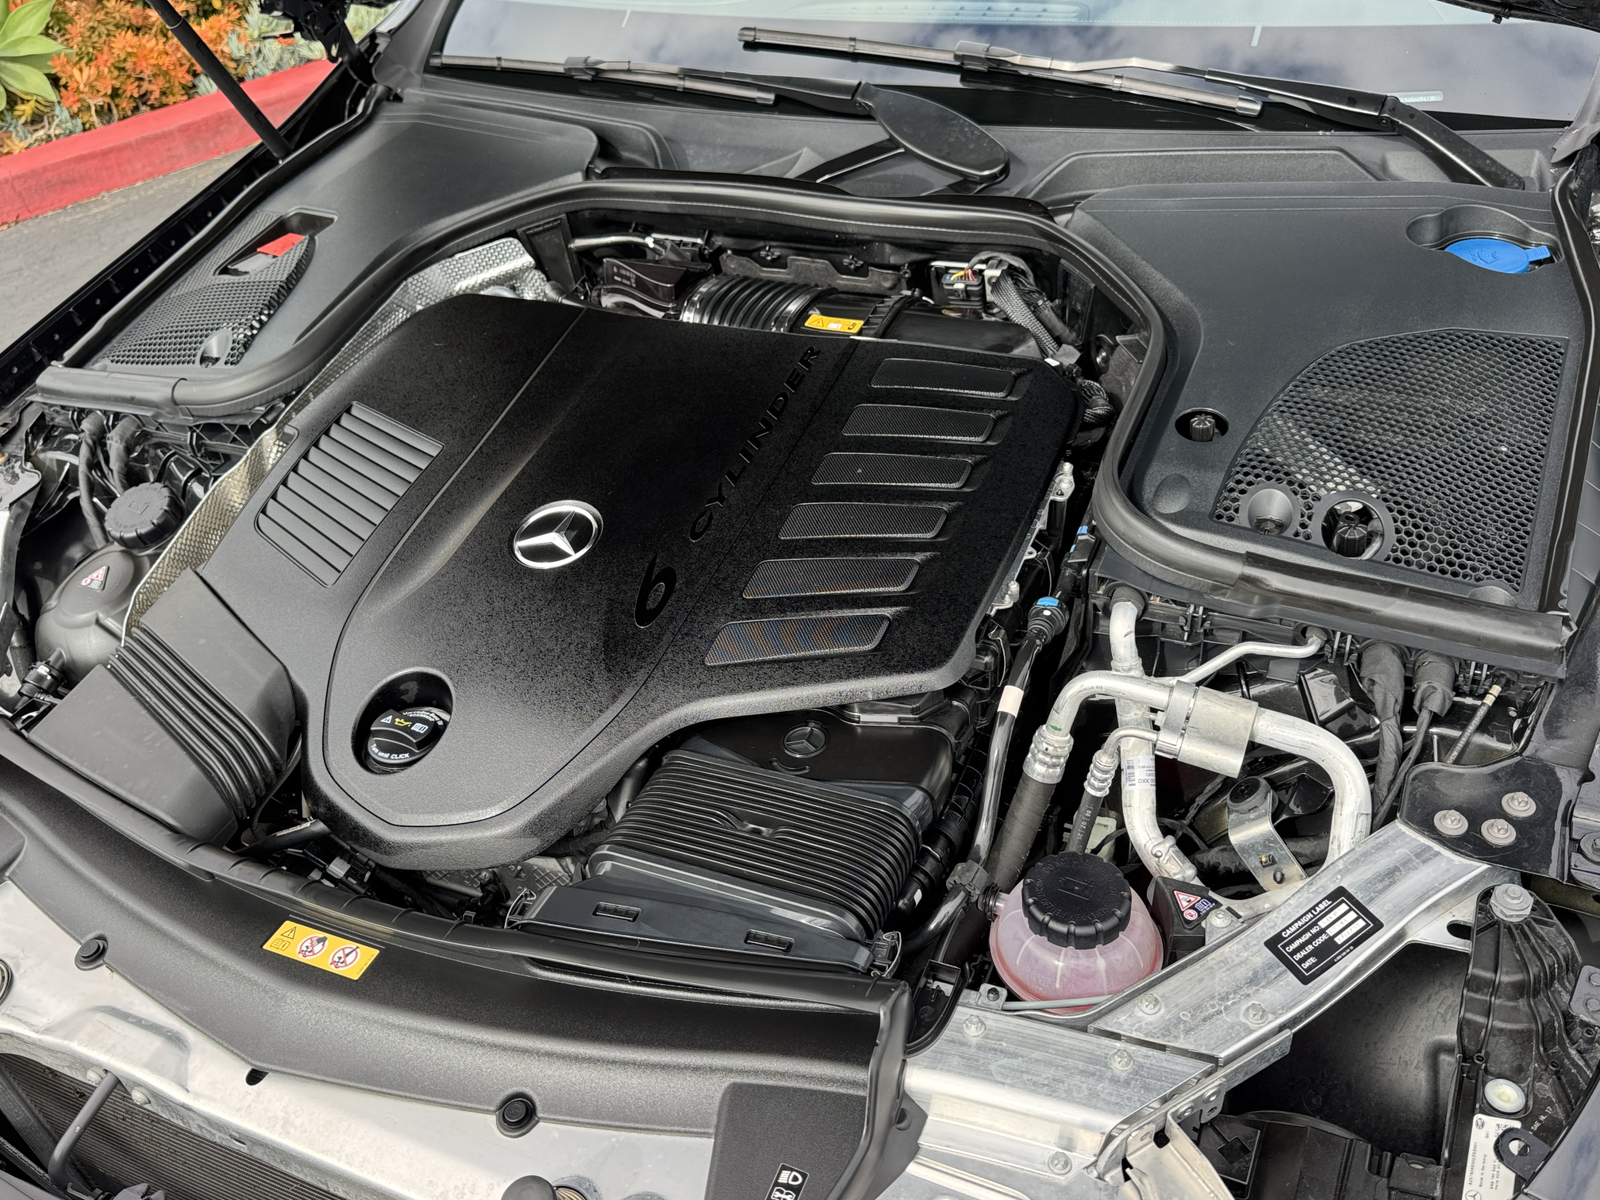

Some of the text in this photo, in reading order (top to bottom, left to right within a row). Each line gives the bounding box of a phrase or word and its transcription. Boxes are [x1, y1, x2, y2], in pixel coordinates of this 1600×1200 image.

[634, 345, 822, 629] 6 CYLINDER
[1281, 912, 1315, 938] CAMPAIGN
[1312, 899, 1333, 916] LABEL
[1285, 932, 1313, 953] CAMPAIGN
[1311, 924, 1322, 935] NO:
[1293, 944, 1314, 961] DEALER
[1312, 932, 1331, 947] CODE:
[1301, 957, 1318, 970] DATE:
